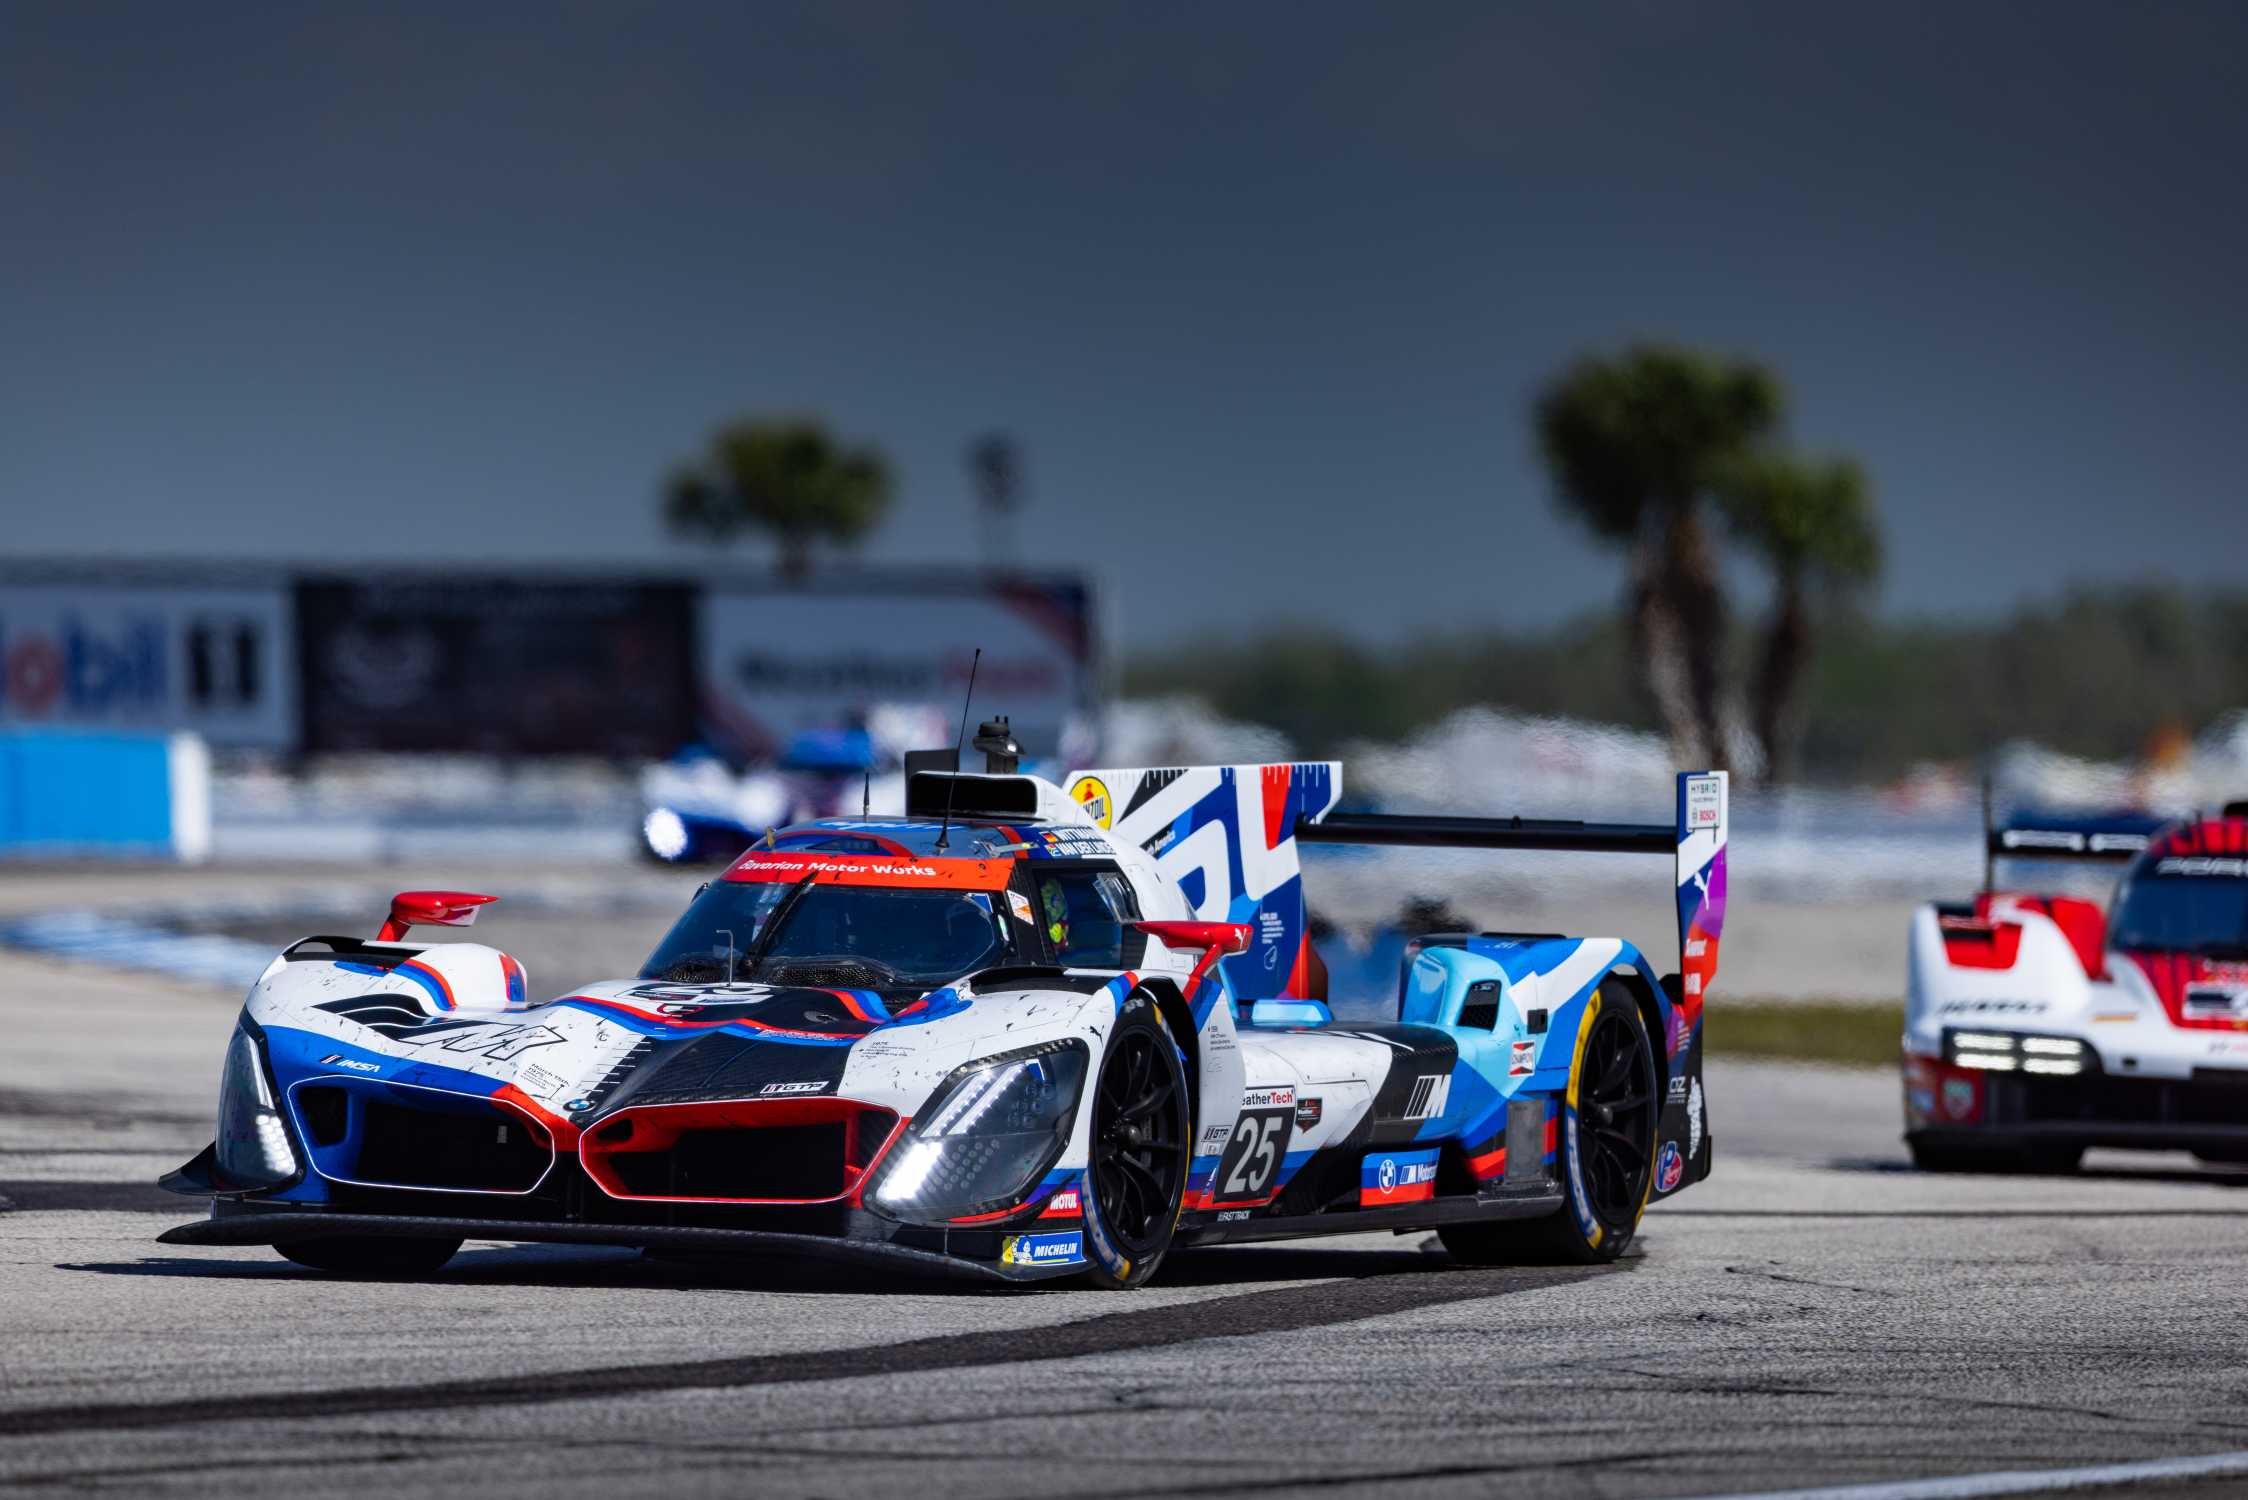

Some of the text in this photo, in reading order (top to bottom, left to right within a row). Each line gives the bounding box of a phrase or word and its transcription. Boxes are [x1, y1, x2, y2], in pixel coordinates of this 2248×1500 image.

[0, 608, 167, 714] obil
[1699, 809, 1716, 821] BOSCH
[738, 859, 936, 876] Bavarian Motor Works
[336, 1059, 381, 1073] IMSA
[782, 1083, 823, 1092] GTP
[1669, 1076, 1686, 1093] OZ
[1241, 1090, 1294, 1106] eatherTech
[1224, 1116, 1283, 1194] 25
[1049, 1193, 1077, 1210] MOTUL
[1034, 1242, 1078, 1257] MICHELIN
